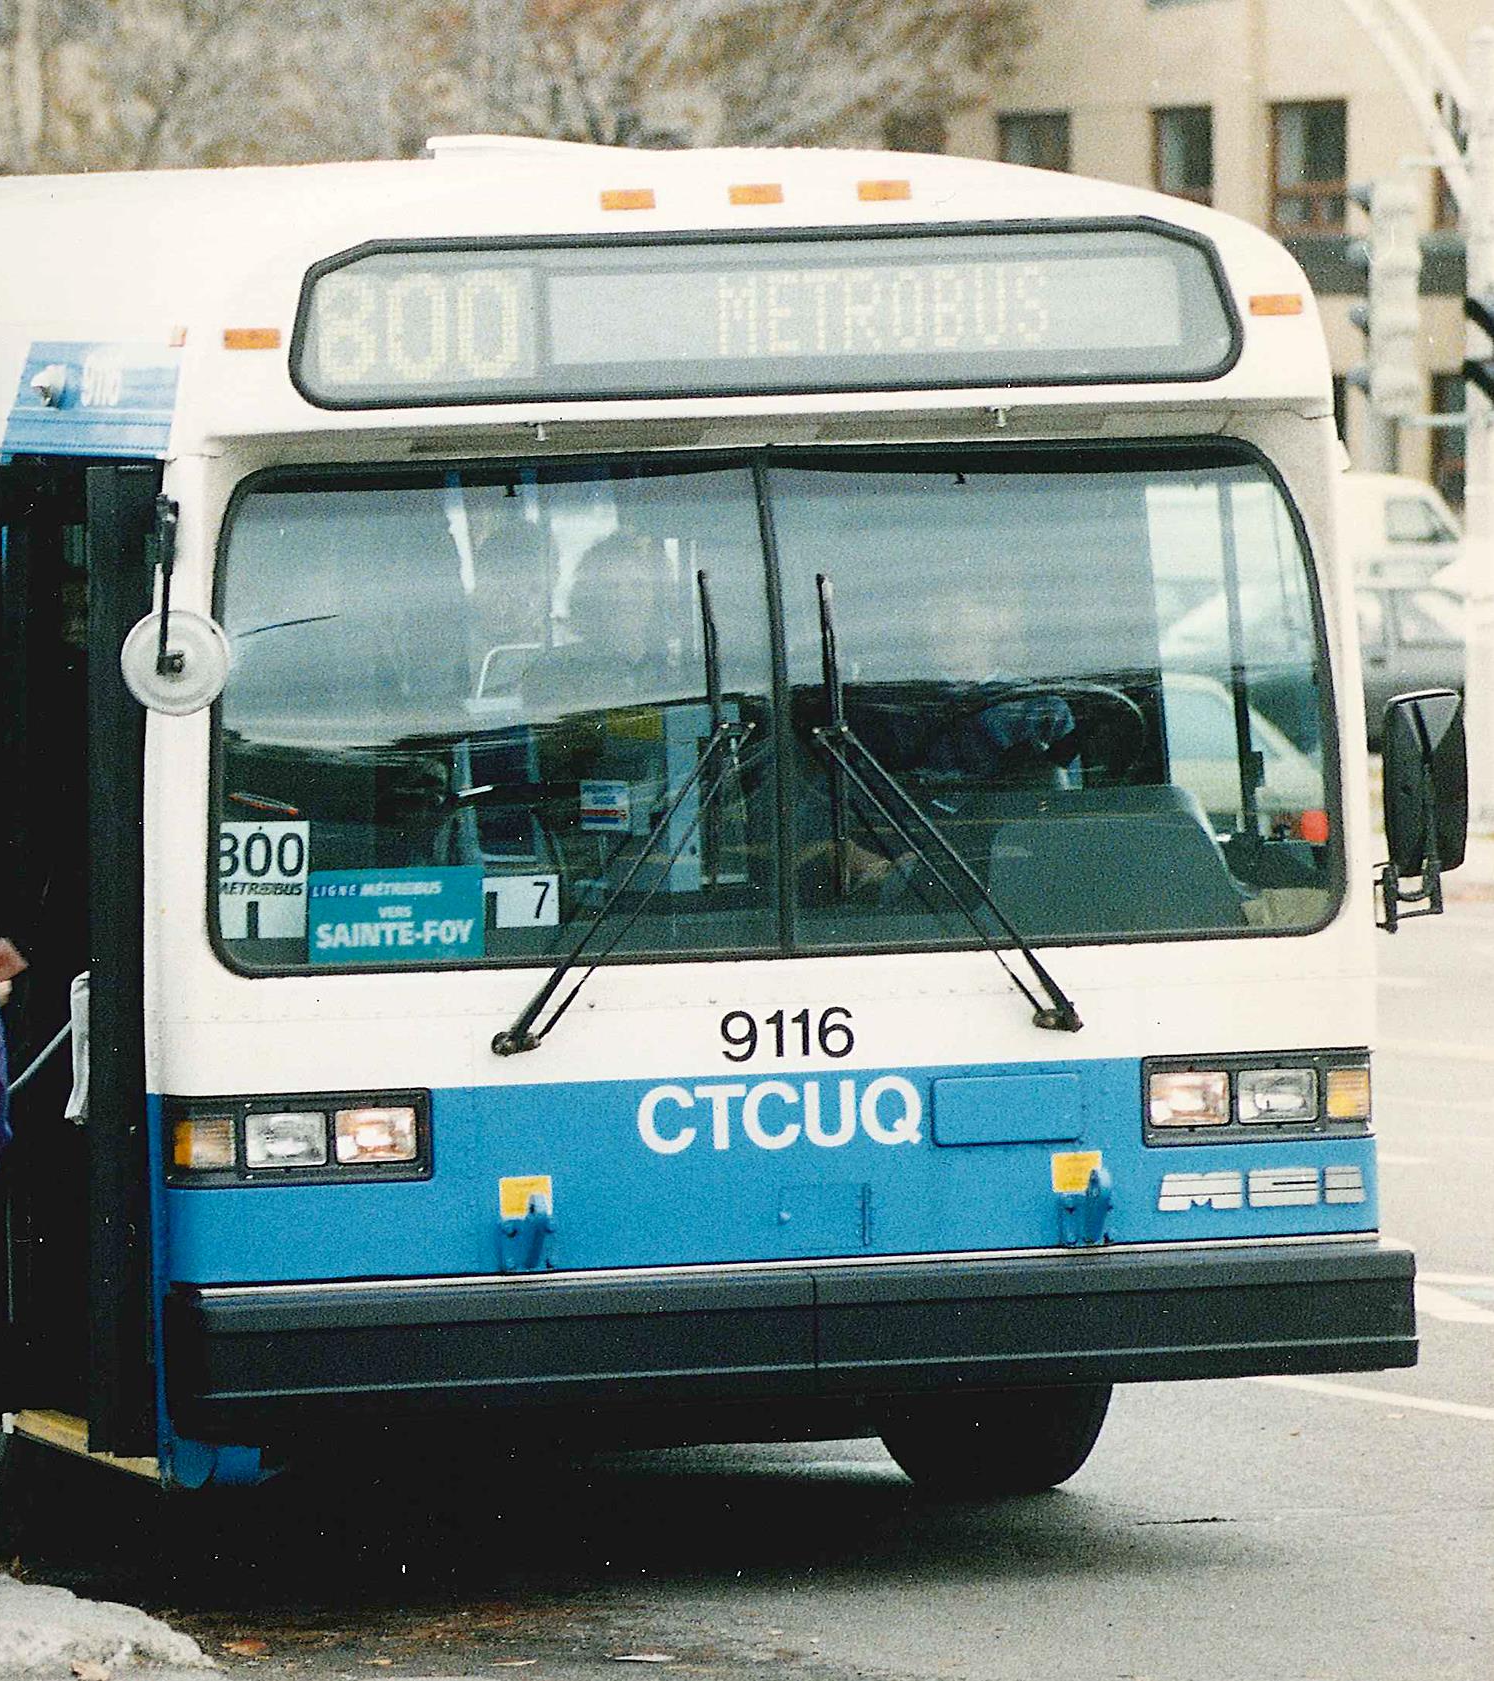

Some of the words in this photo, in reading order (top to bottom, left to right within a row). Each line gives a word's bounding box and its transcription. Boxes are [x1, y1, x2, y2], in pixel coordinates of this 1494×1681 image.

[315, 269, 521, 381] 800
[717, 264, 1049, 356] METROBUS
[312, 884, 357, 898] LIGNE
[315, 919, 475, 949] SAINTE-FOY
[720, 1006, 855, 1062] 9116
[637, 1075, 924, 1155] CTCUQ
